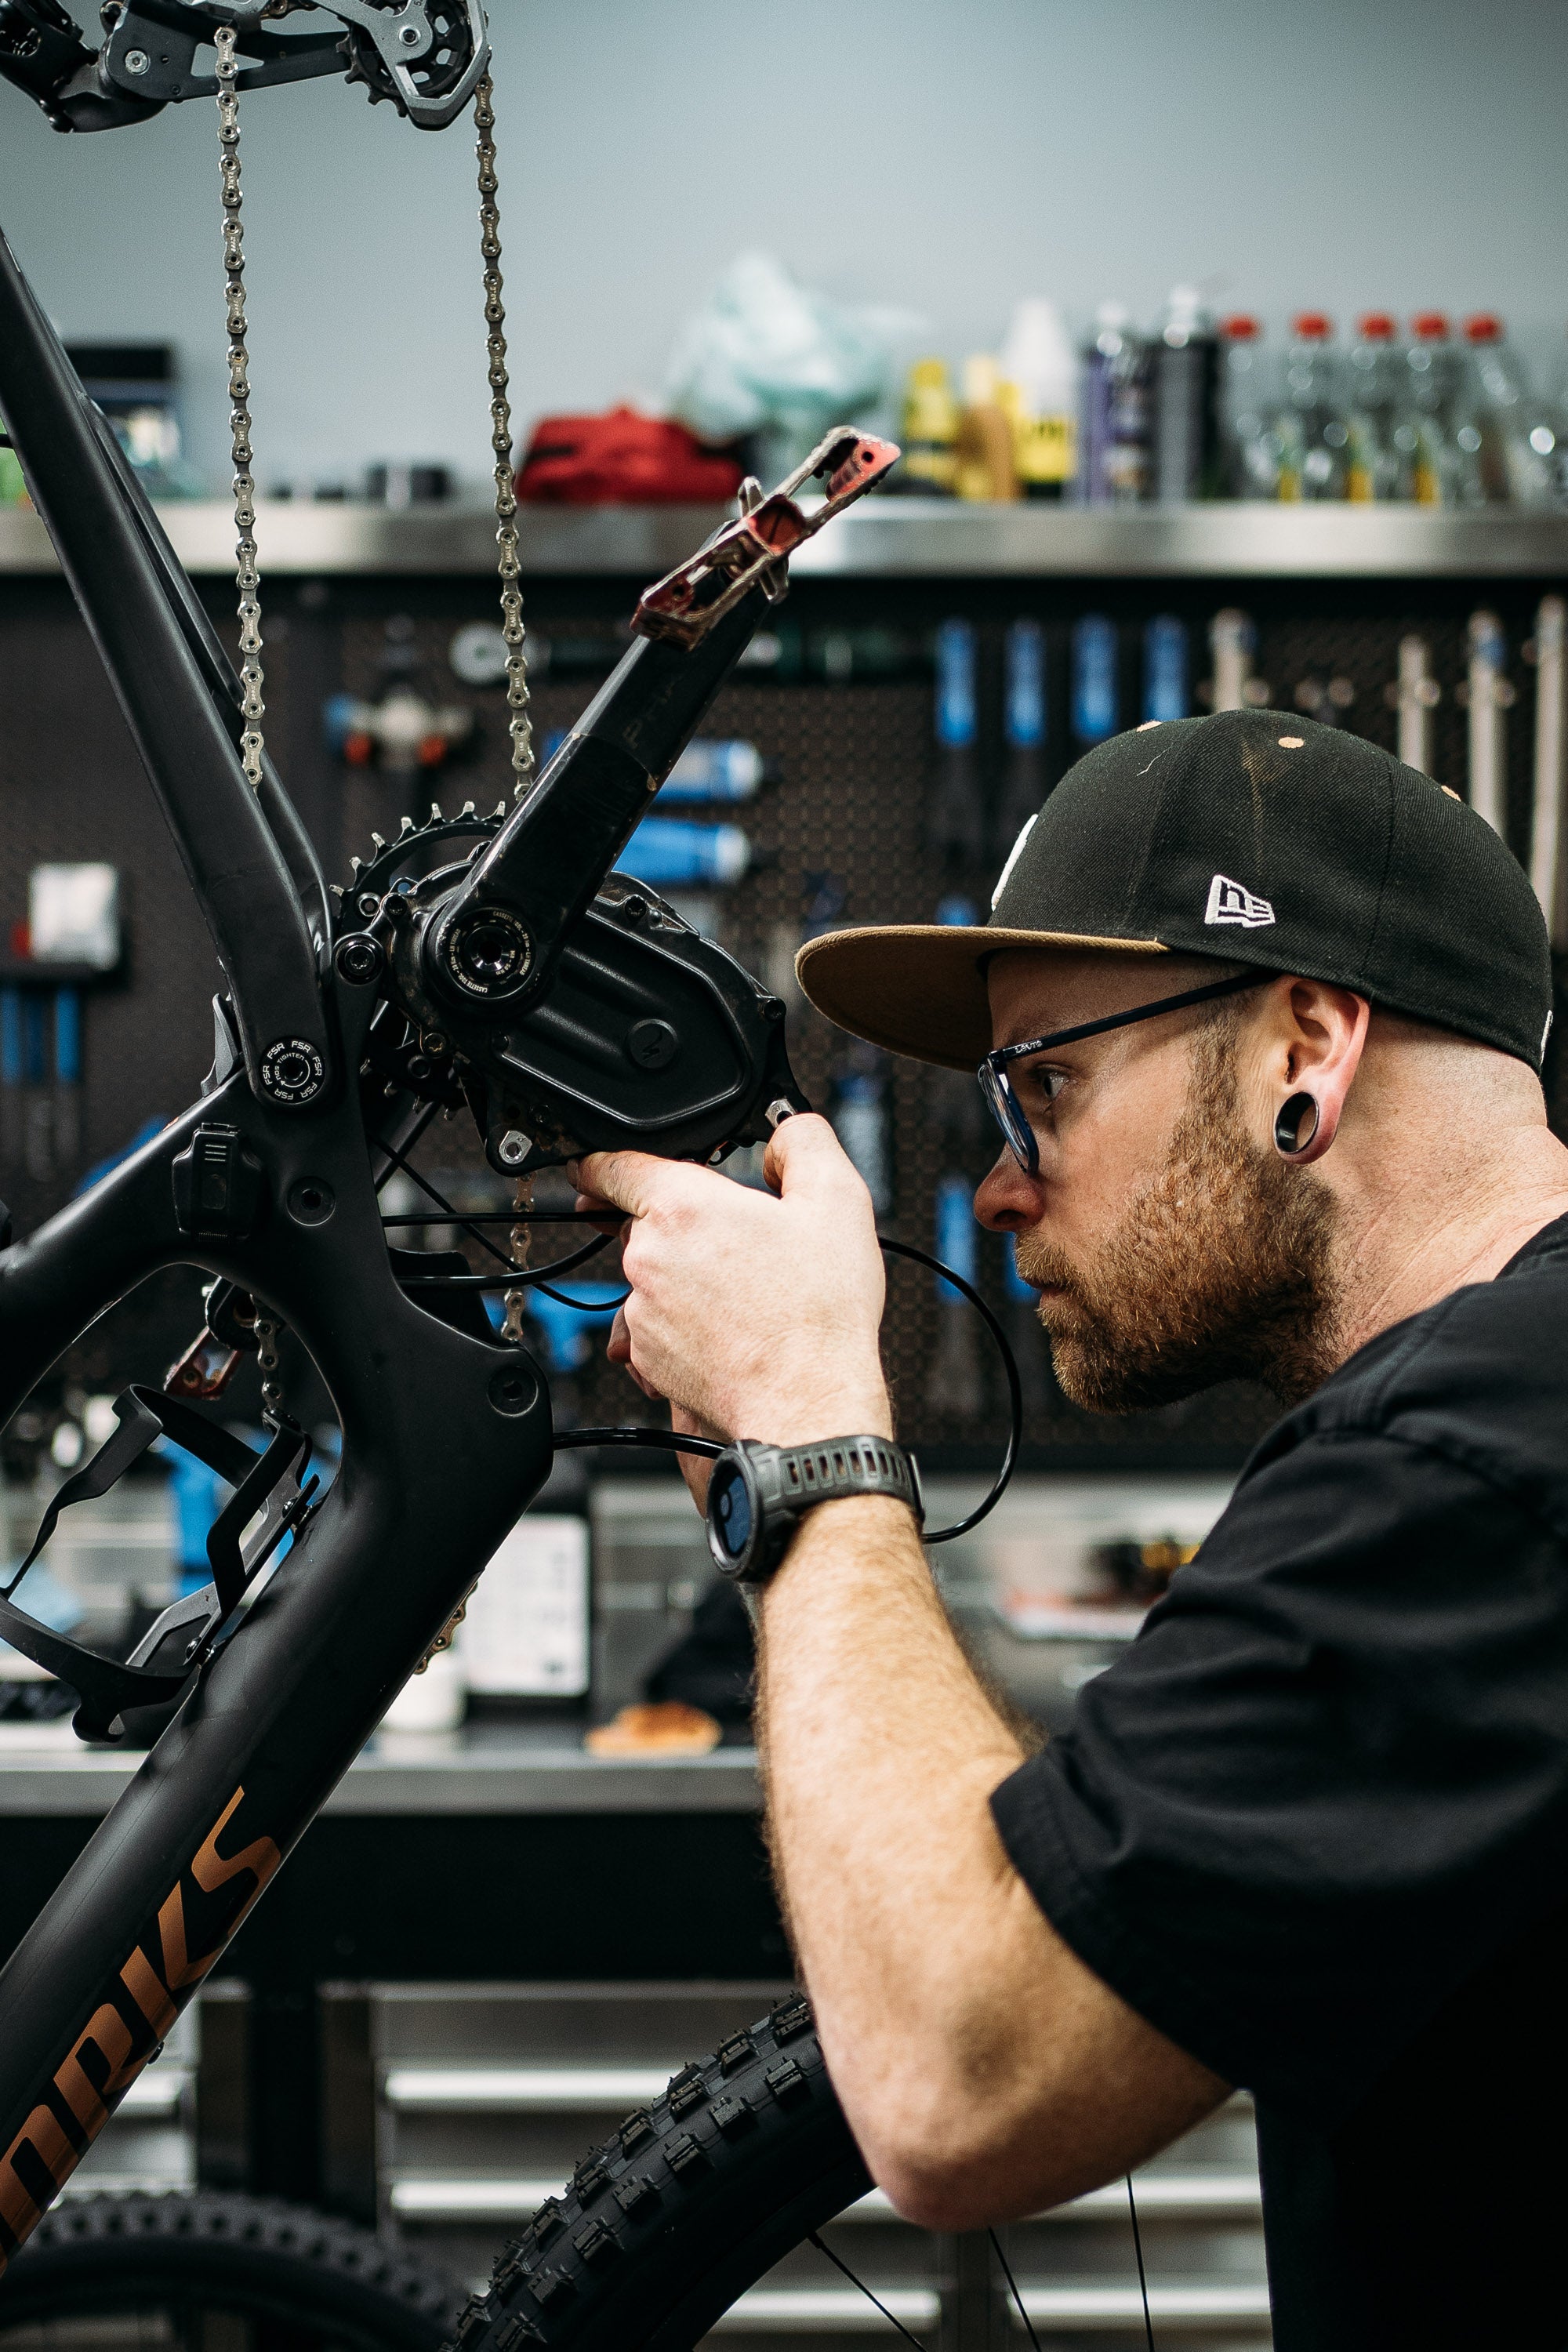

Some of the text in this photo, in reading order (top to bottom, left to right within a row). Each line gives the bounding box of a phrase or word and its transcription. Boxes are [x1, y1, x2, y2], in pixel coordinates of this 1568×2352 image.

[492, 910, 514, 924] CASSETTE
[466, 980, 488, 993] CASSETTE
[267, 1043, 285, 1060] FSR
[291, 1040, 311, 1054] FSR
[277, 1052, 305, 1064] TIGHTEN
[312, 1056, 322, 1076] FSR
[263, 1065, 273, 1086] FSR
[274, 1088, 294, 1101] FSR
[299, 1082, 318, 1098] FSR
[0, 1784, 281, 2278] ORKS
